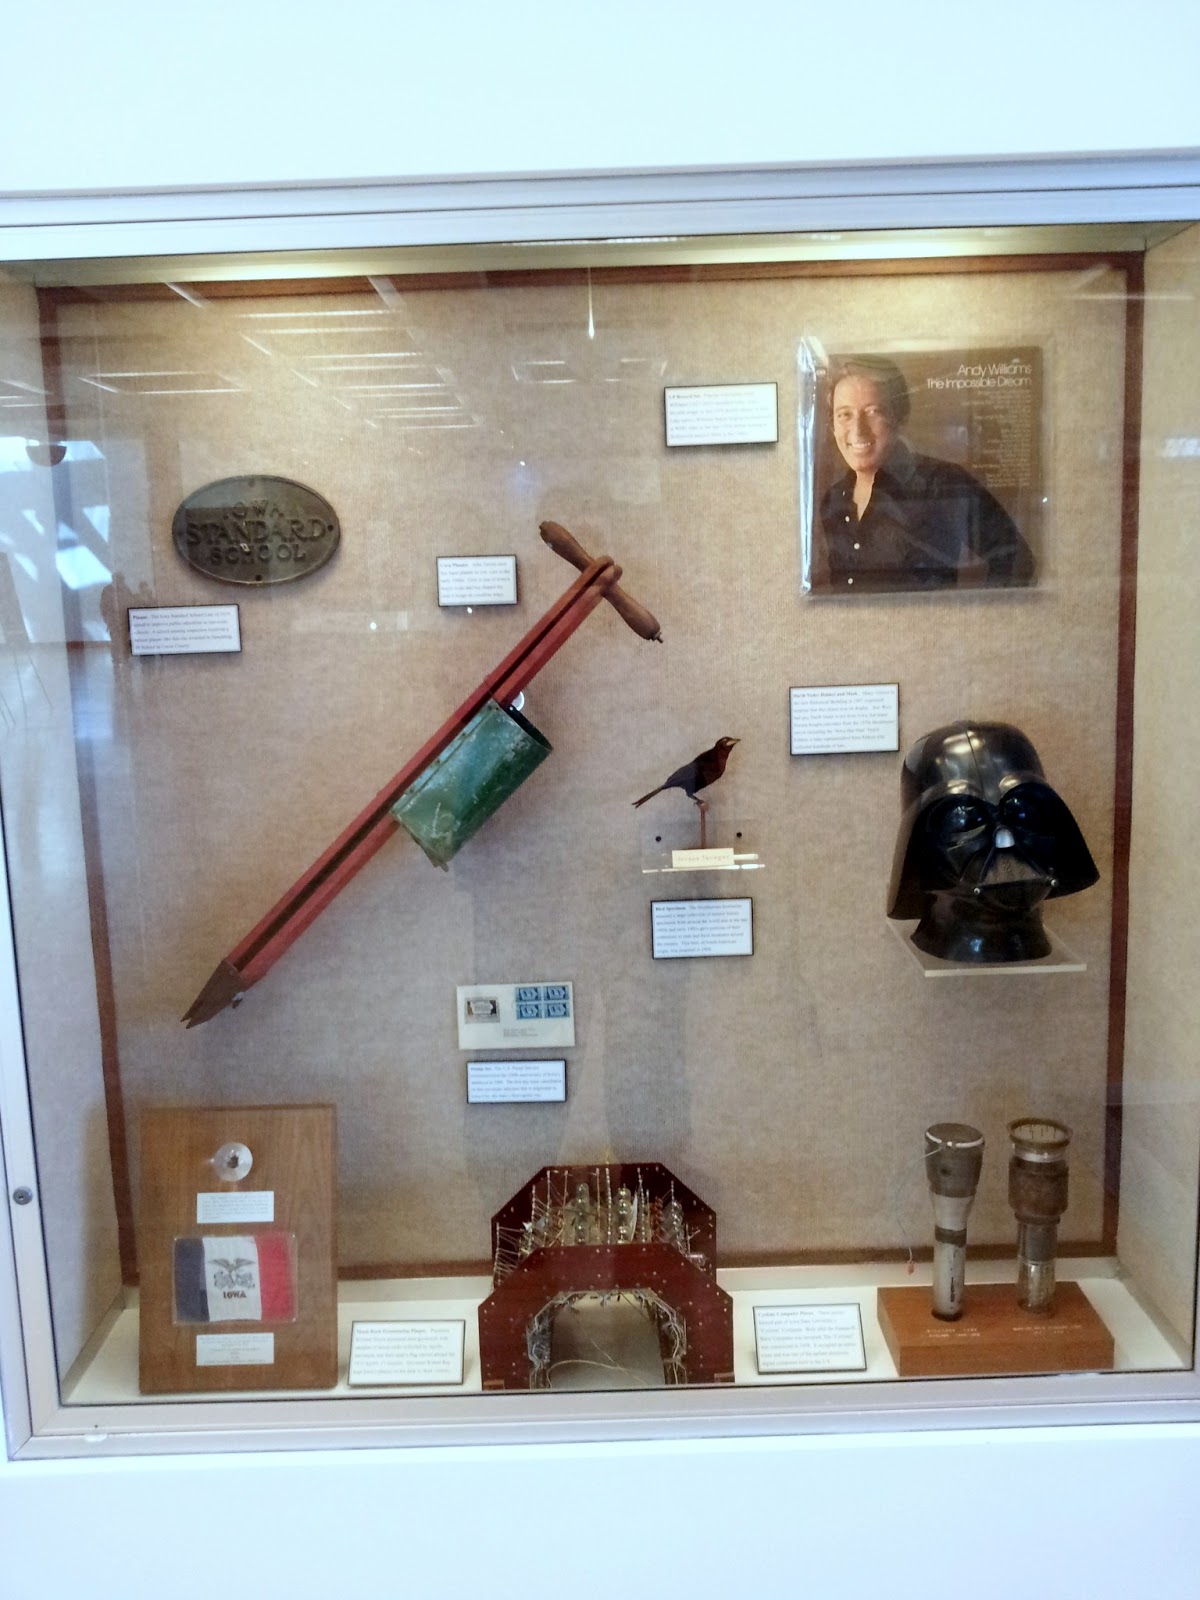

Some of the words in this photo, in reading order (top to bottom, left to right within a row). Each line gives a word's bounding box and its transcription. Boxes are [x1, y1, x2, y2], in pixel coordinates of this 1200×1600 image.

[957, 364, 987, 377] Andy
[988, 363, 1032, 375] Williams
[927, 378, 945, 389] The
[945, 378, 997, 390] Impossible
[997, 376, 1032, 387] Dream
[222, 500, 285, 519] OWA
[186, 518, 326, 545] STANDARD
[210, 543, 306, 564] SCHOOL
[223, 1291, 247, 1299] IOWA
